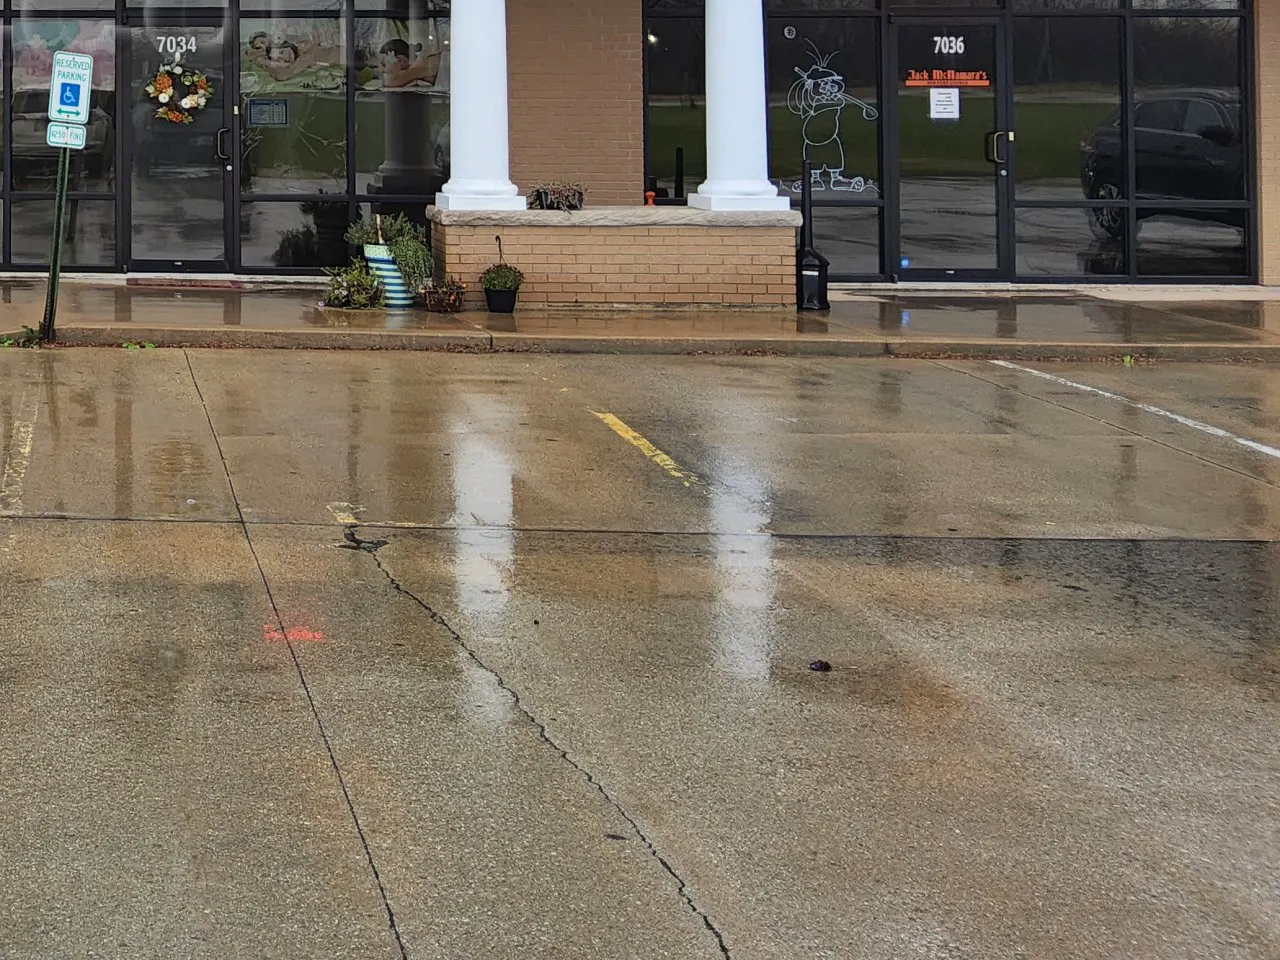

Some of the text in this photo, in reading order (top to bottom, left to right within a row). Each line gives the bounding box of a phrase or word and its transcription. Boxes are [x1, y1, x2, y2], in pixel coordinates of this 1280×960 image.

[156, 36, 197, 53] 7034
[933, 36, 965, 54] 7036
[56, 58, 90, 71] RESERVED
[57, 70, 87, 82] PARKING
[907, 69, 987, 80] Jack McNamara's
